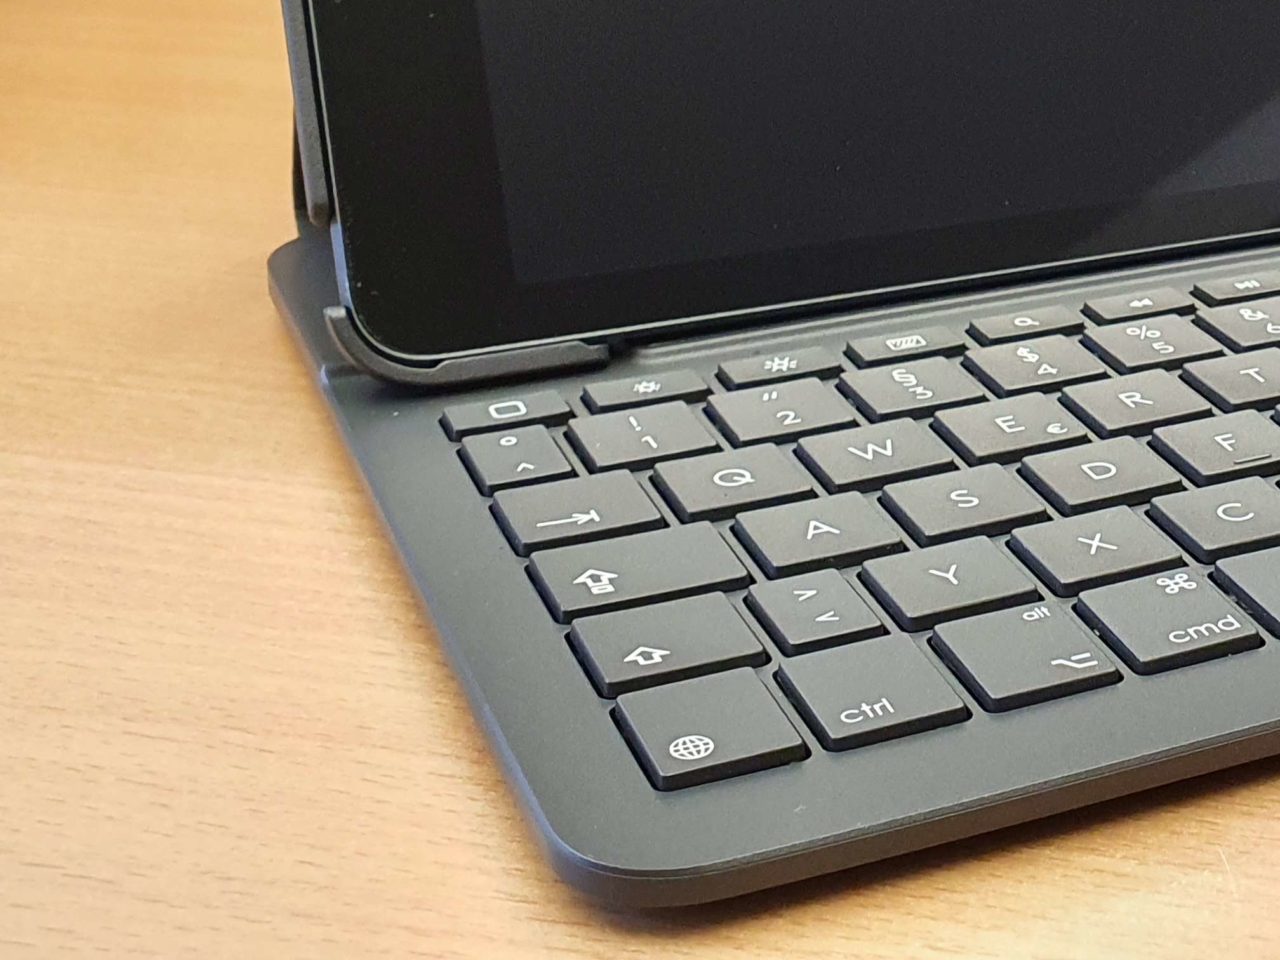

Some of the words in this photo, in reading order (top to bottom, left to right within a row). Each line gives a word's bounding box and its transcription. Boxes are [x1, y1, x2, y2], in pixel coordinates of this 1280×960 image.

[1124, 323, 1163, 341] %
[1151, 341, 1175, 354] 5
[1035, 361, 1059, 375] 4
[1239, 367, 1265, 383] T
[907, 384, 935, 401] 3
[1118, 391, 1154, 408] R
[628, 415, 642, 432] !
[776, 410, 802, 426] 2
[994, 415, 1026, 433] E
[641, 435, 658, 449] 1
[847, 438, 893, 460] W
[1214, 433, 1236, 452] F
[712, 468, 755, 487] Q
[1080, 461, 1117, 480] D
[950, 489, 980, 508] S
[1216, 502, 1255, 522] C
[806, 520, 841, 540] A
[1077, 532, 1118, 555] X
[928, 564, 959, 585] Y
[1022, 606, 1051, 621] alt
[1168, 614, 1242, 643] cmd
[840, 697, 895, 723] ctrl
